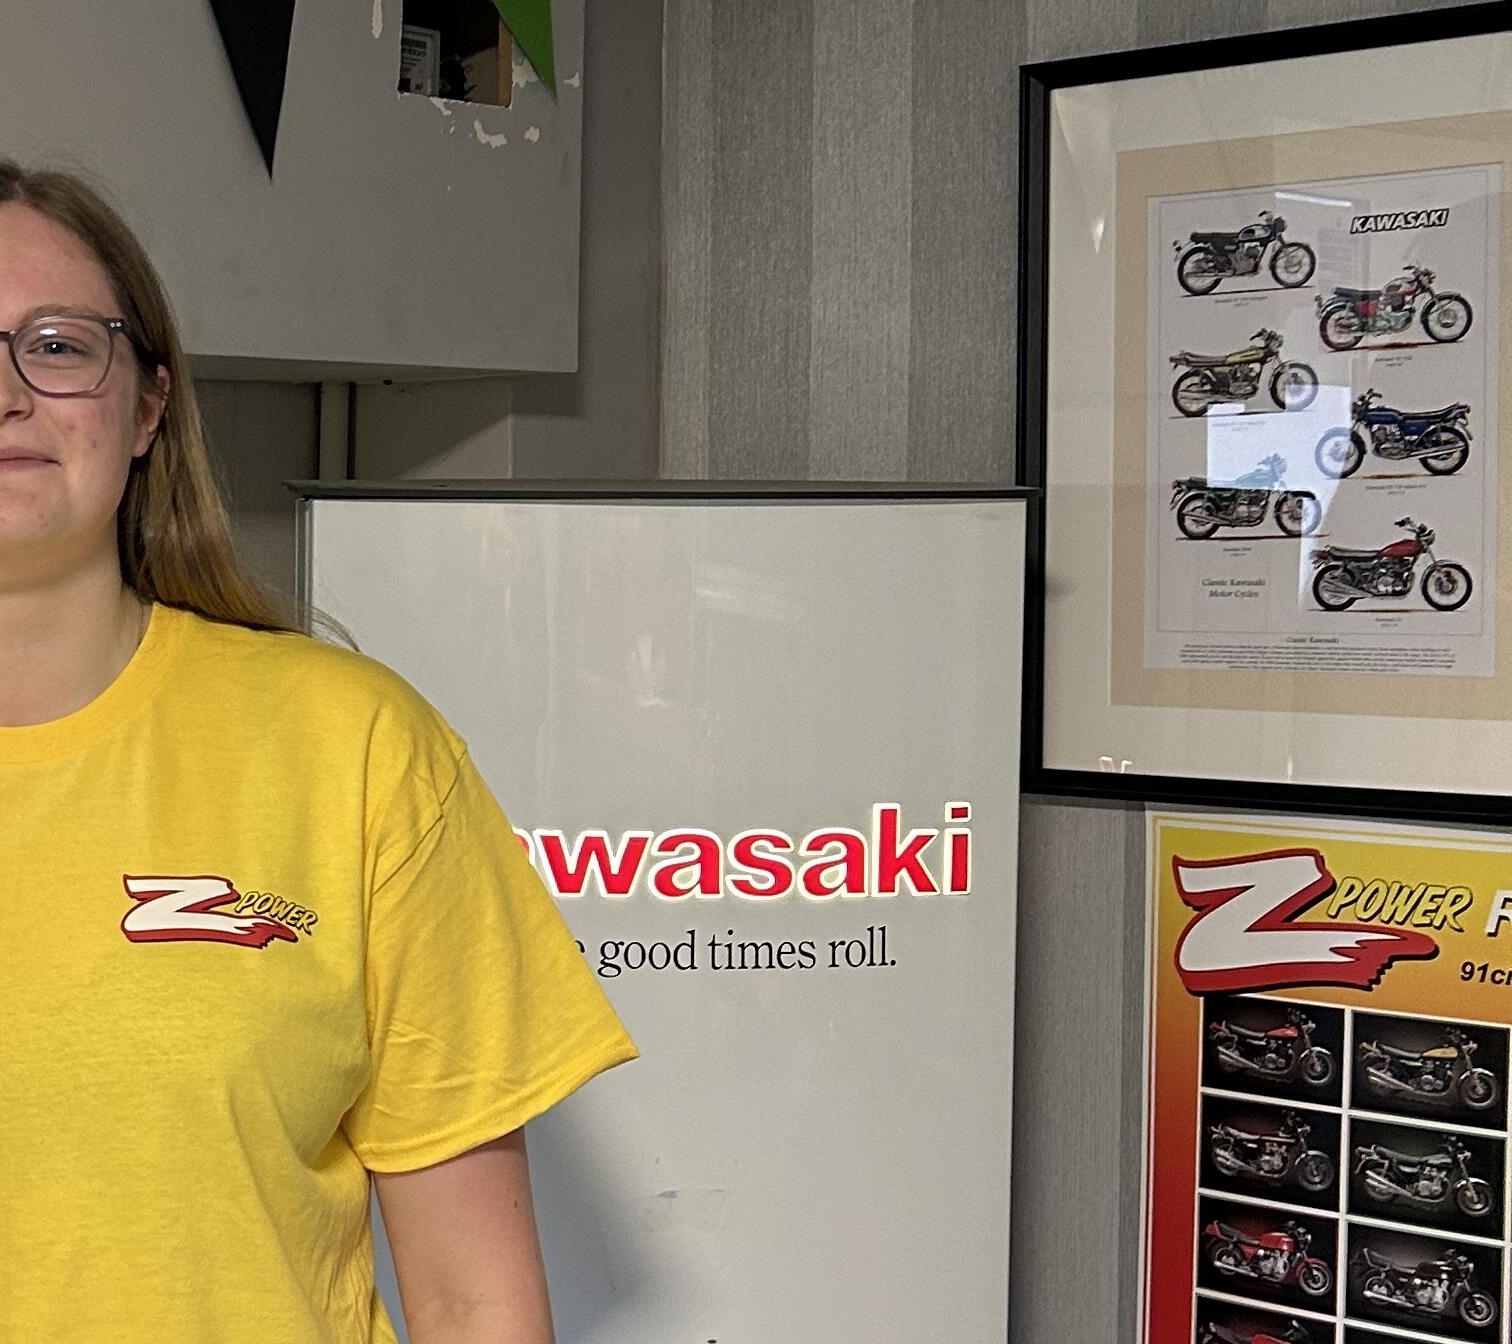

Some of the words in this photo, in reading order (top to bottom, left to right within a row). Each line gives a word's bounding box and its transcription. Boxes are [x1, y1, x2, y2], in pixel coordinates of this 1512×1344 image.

[1349, 207, 1450, 235] KAWASAKI
[511, 800, 973, 900] wasaki
[234, 891, 318, 936] POWER
[1326, 875, 1474, 933] POWER
[597, 929, 697, 978] good
[709, 929, 818, 971] times
[827, 925, 898, 969] roll.
